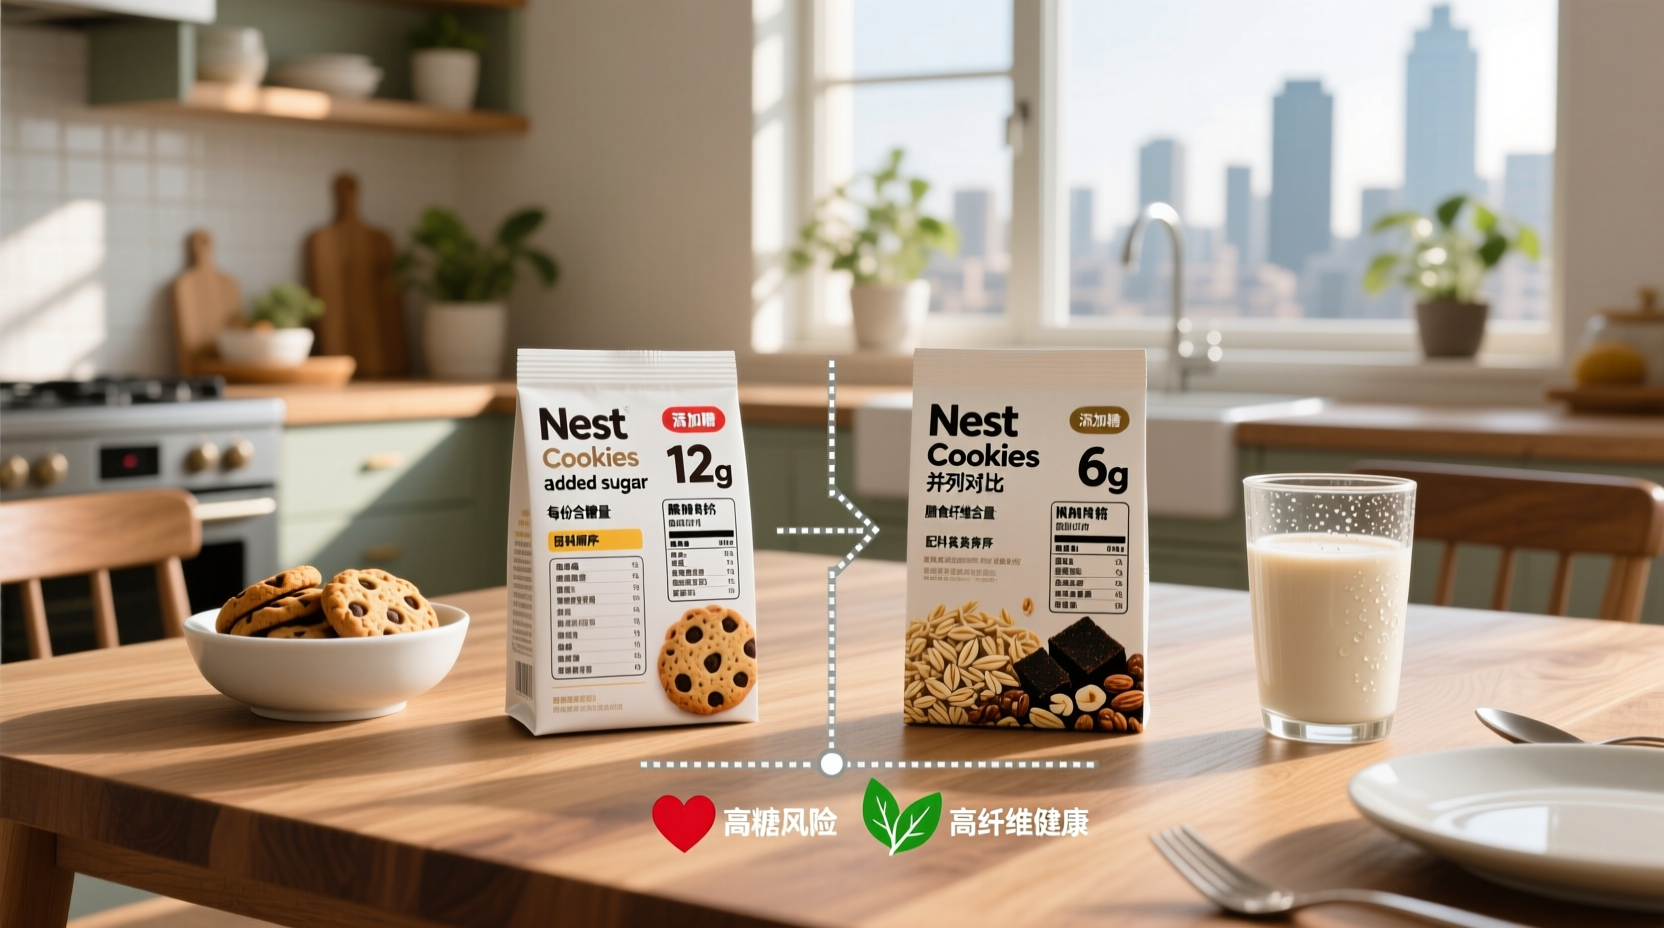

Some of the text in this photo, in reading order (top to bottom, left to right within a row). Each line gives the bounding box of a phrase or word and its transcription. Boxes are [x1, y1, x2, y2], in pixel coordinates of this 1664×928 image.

[539, 407, 629, 441] Nest
[929, 403, 1019, 438] Nest
[542, 446, 640, 469] Cookies
[666, 443, 733, 489] 12g
[927, 442, 1040, 468] Cookies
[544, 474, 649, 494] added sugar
[926, 472, 1004, 493] 并列对比
[1078, 446, 1129, 495] 6g
